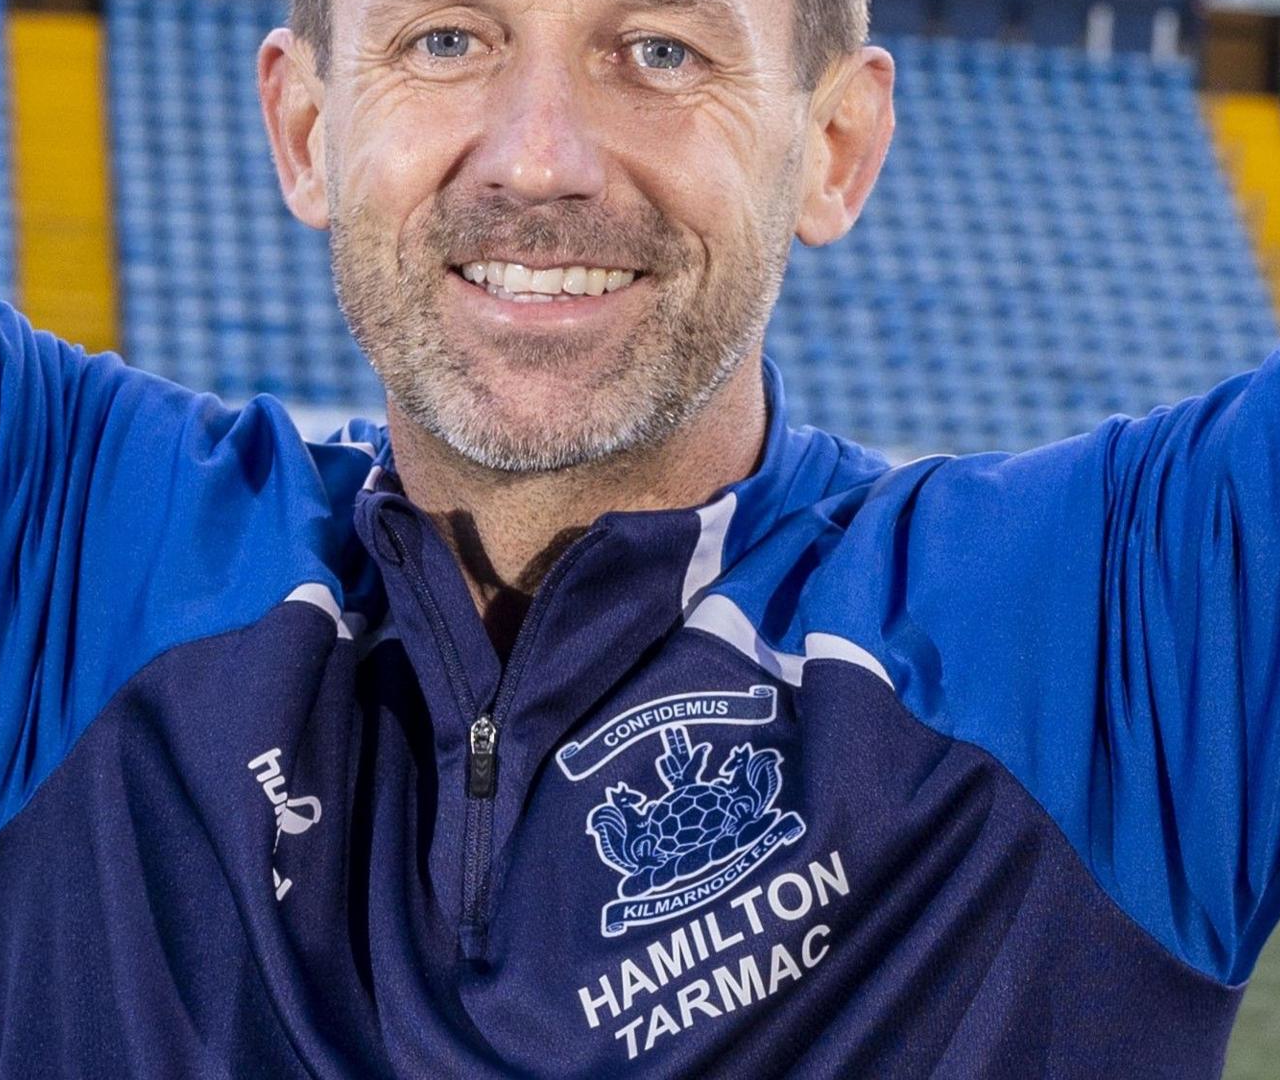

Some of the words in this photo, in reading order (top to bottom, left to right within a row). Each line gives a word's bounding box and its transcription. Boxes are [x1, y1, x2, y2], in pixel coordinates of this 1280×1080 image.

[603, 699, 730, 748] CONFIDEMUS
[622, 859, 751, 920] KILMARNOCK
[751, 830, 784, 860] F.C.
[577, 850, 851, 1029] HAMILTON
[614, 924, 832, 1061] TARMAC
